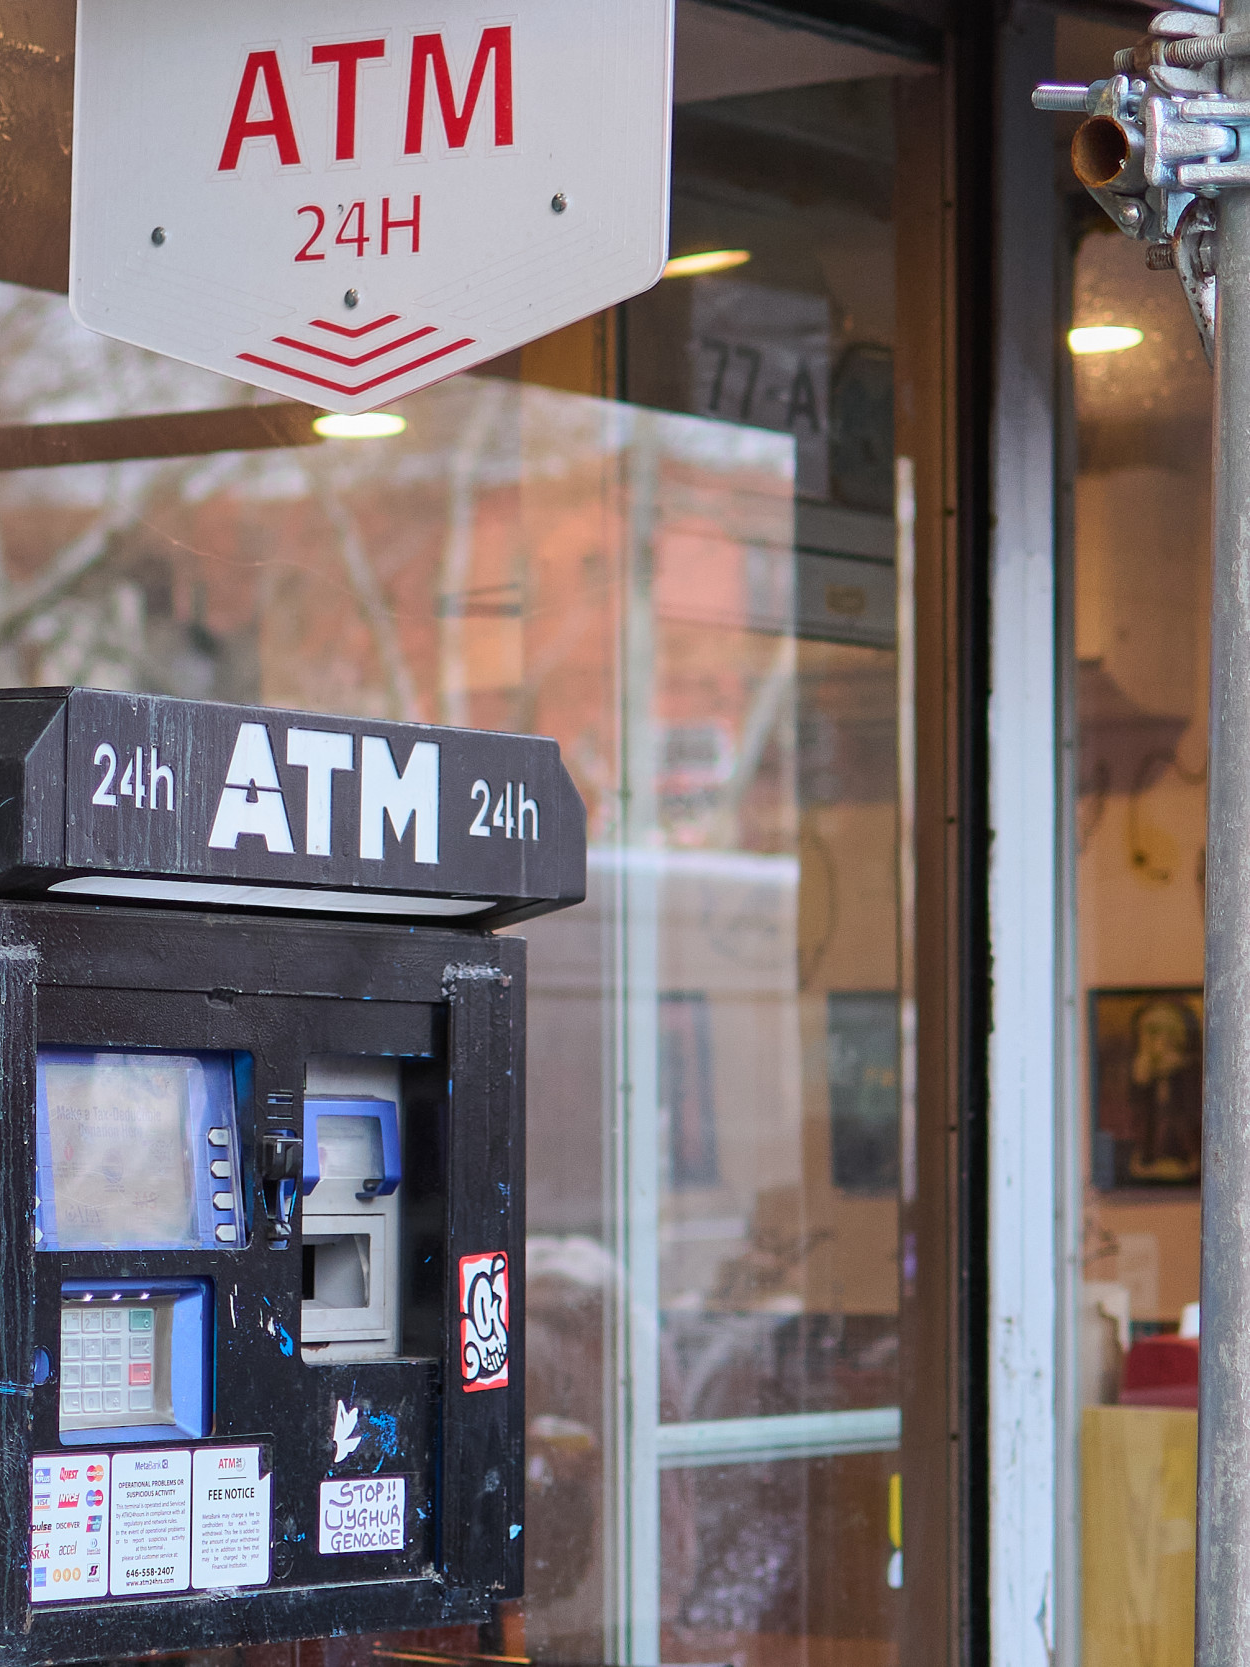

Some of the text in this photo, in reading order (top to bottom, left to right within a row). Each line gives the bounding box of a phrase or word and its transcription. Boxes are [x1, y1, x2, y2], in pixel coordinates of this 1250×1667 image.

[217, 25, 514, 171] ATM
[293, 194, 421, 262] 24H
[92, 722, 540, 864] 24h ATM 24h
[56, 1105, 82, 1120] Make
[135, 1461, 161, 1470] MetaBank
[218, 1458, 235, 1469] ATM
[59, 1493, 80, 1503] NYCE
[127, 1490, 154, 1498] SUSPICIOUS
[208, 1487, 254, 1500] FEE NOTICE
[325, 1504, 400, 1530] UYGHUR
[31, 1549, 50, 1560] STAR
[126, 1566, 174, 1578] 646-558-2407
[126, 1578, 174, 1586] www.atm24hrs.com
